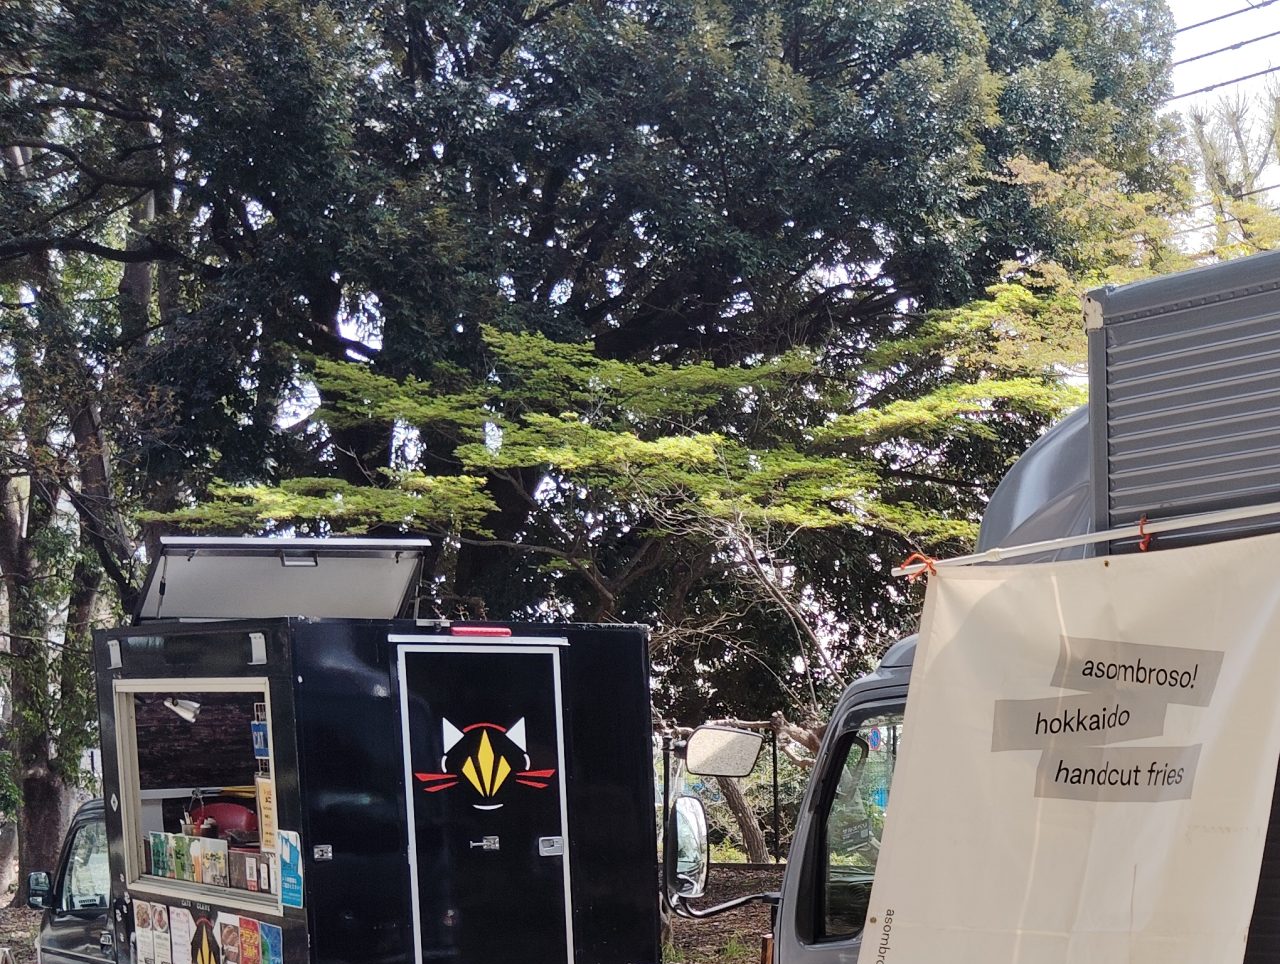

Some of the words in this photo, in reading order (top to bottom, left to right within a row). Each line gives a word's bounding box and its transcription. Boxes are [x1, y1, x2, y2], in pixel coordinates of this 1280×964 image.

[1082, 658, 1199, 689] asombroso!
[1035, 704, 1130, 735] hokkaido
[1055, 760, 1142, 787] handcut
[1147, 761, 1185, 787] fries
